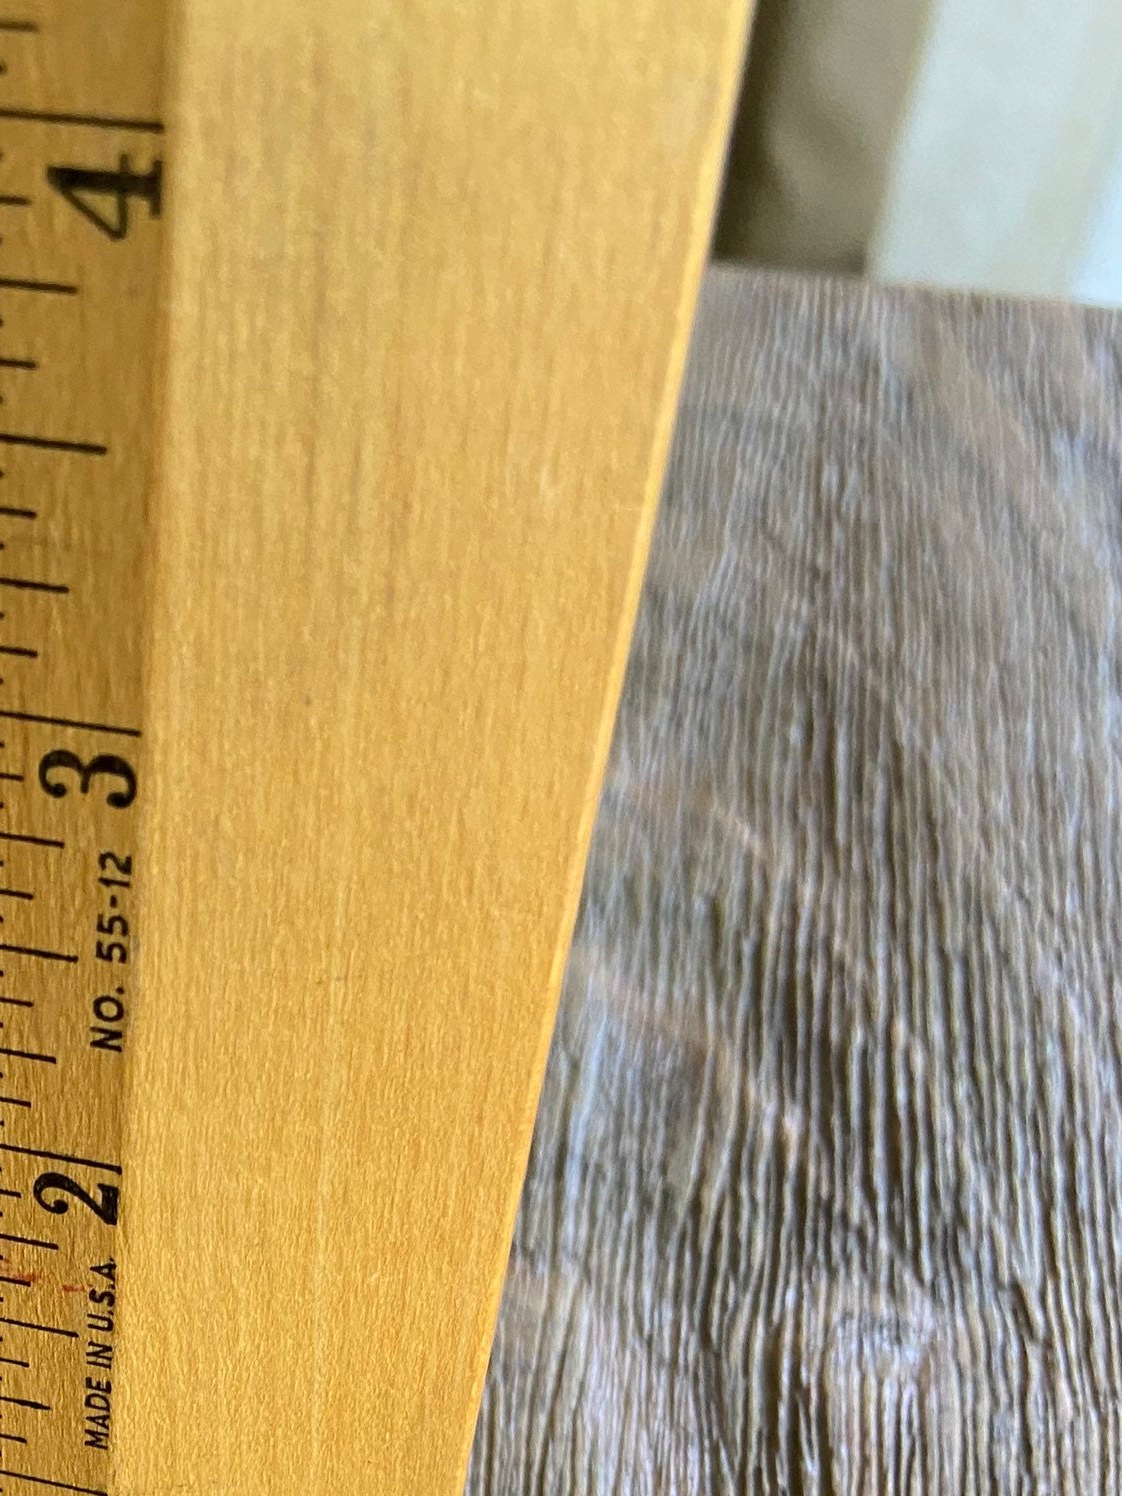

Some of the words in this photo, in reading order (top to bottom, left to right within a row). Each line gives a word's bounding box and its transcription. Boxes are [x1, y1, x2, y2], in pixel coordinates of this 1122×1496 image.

[46, 153, 163, 242] 4
[39, 749, 138, 809] 3
[95, 852, 133, 964] 55-12
[90, 986, 125, 1053] NO.
[33, 1171, 119, 1226] 2
[85, 1341, 112, 1370] IN
[84, 1376, 112, 1450] MADE
